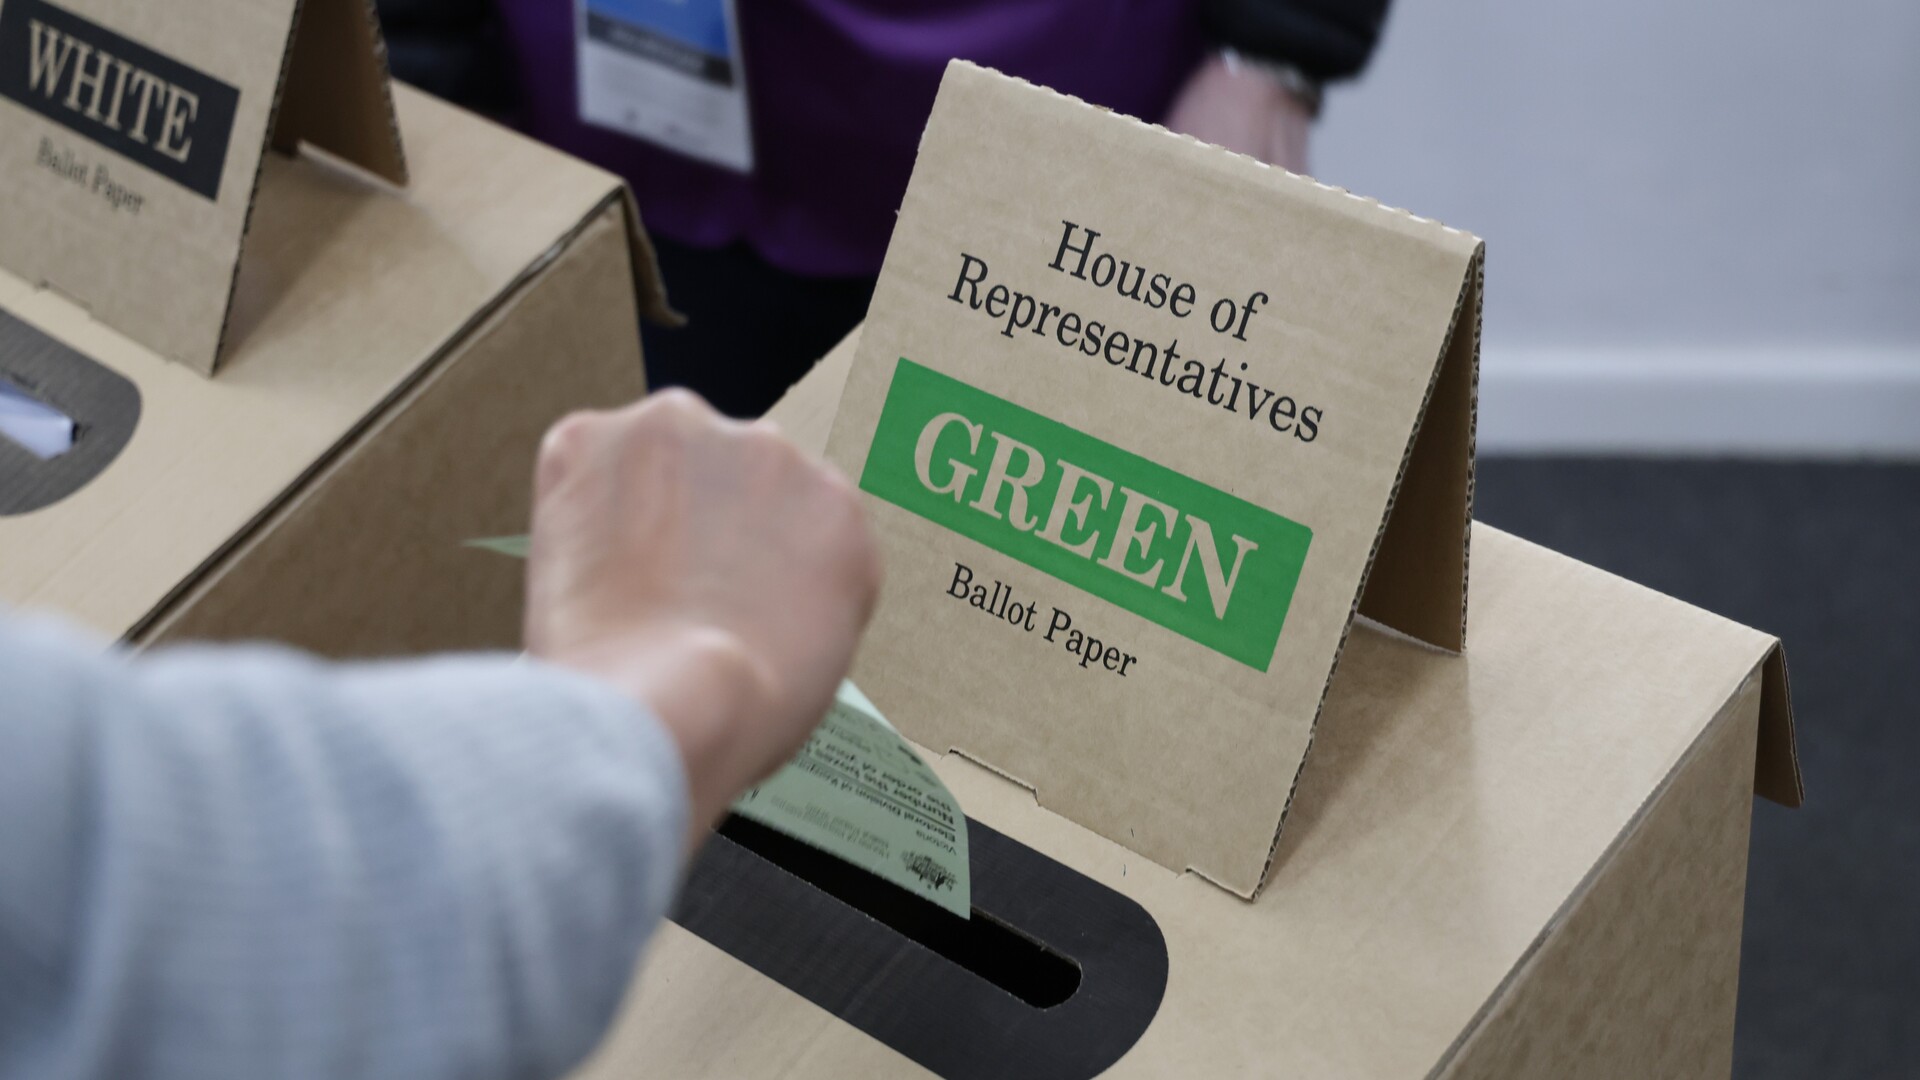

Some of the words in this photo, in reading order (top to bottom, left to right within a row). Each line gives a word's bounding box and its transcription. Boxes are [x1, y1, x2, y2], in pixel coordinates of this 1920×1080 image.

[29, 18, 199, 163] WHITE
[36, 137, 90, 189] Ballot
[92, 164, 145, 214] Paper
[1048, 220, 1196, 318] House
[1210, 291, 1268, 342] of
[947, 253, 1323, 443] Representatives
[914, 411, 1259, 621] GREEN
[946, 563, 1038, 632] Ballot
[1043, 608, 1138, 678] Paper
[882, 771, 923, 797] order
[894, 788, 955, 825] Number
[903, 811, 956, 843] Electoral
[916, 829, 957, 856] Victoria
